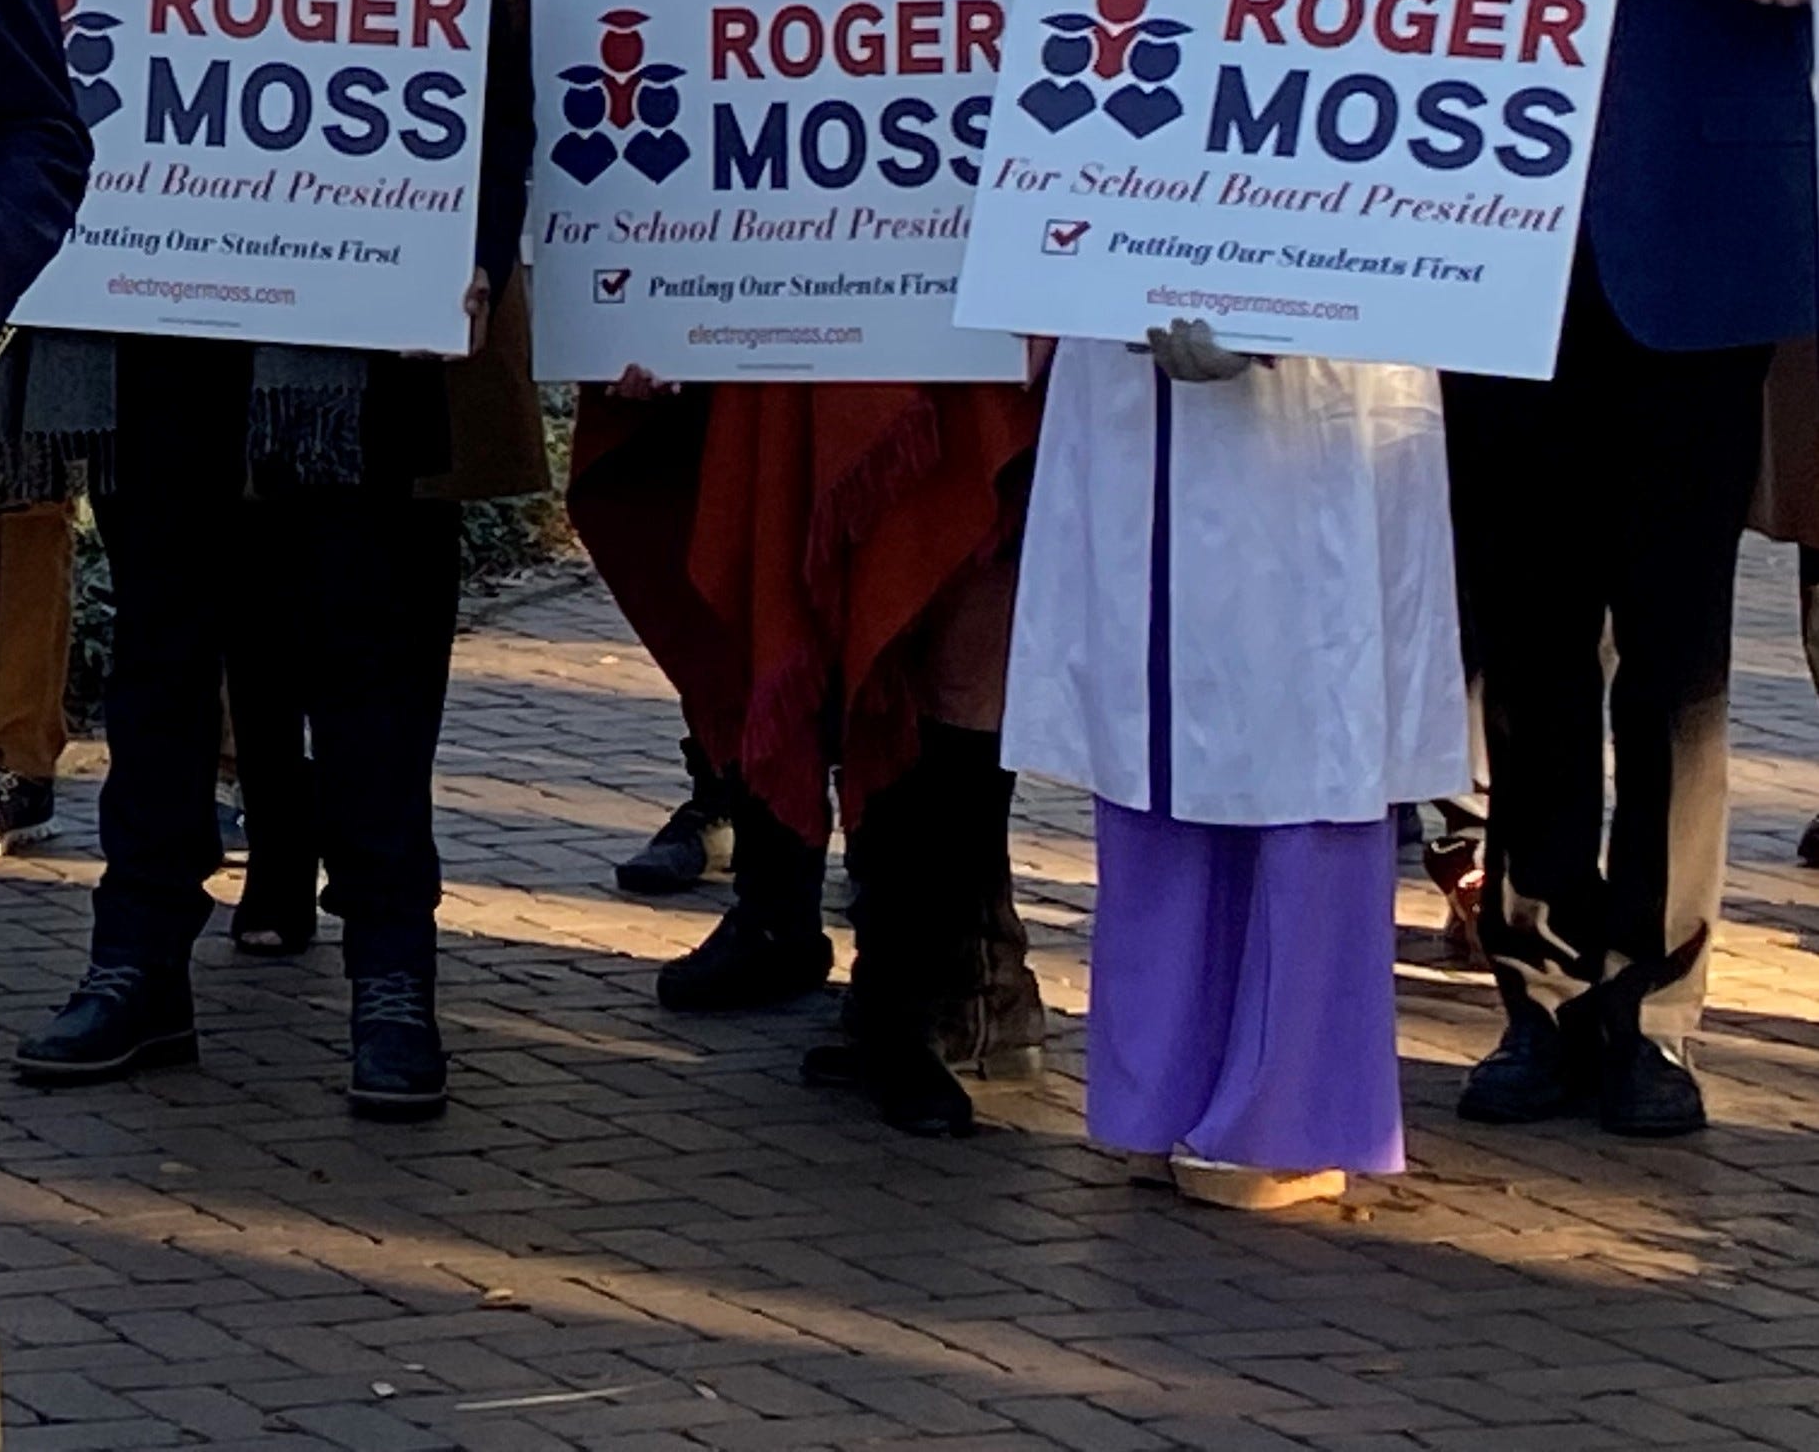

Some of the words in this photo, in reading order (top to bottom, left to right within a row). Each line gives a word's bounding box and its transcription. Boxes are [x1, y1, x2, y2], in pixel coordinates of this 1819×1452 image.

[710, 0, 1006, 80] ROGER
[144, 56, 467, 161] MOSS
[1205, 63, 1579, 179] MOSS
[712, 95, 994, 191] MOSS
[160, 163, 278, 203] Board
[285, 169, 465, 213] President
[992, 157, 1064, 192] For
[1069, 163, 1210, 204] School
[1217, 173, 1354, 215] Board
[1358, 185, 1566, 233] President
[165, 228, 218, 253] Our
[221, 233, 333, 261] Students
[337, 239, 402, 265] First
[543, 210, 600, 245] For
[607, 208, 721, 244] School
[731, 208, 839, 243] Board
[847, 204, 972, 241] Presid
[1108, 231, 1213, 267] Putting
[1217, 240, 1277, 265] Our
[1280, 245, 1408, 277] Students
[1410, 257, 1485, 284] First
[108, 273, 296, 305] electrogermoss.com
[649, 274, 733, 302] Putting
[739, 275, 787, 297] Our
[790, 273, 895, 297] Students
[899, 271, 959, 296] First
[1147, 285, 1360, 322] electrogermoss.com
[688, 323, 863, 349] electrogermoss.com
